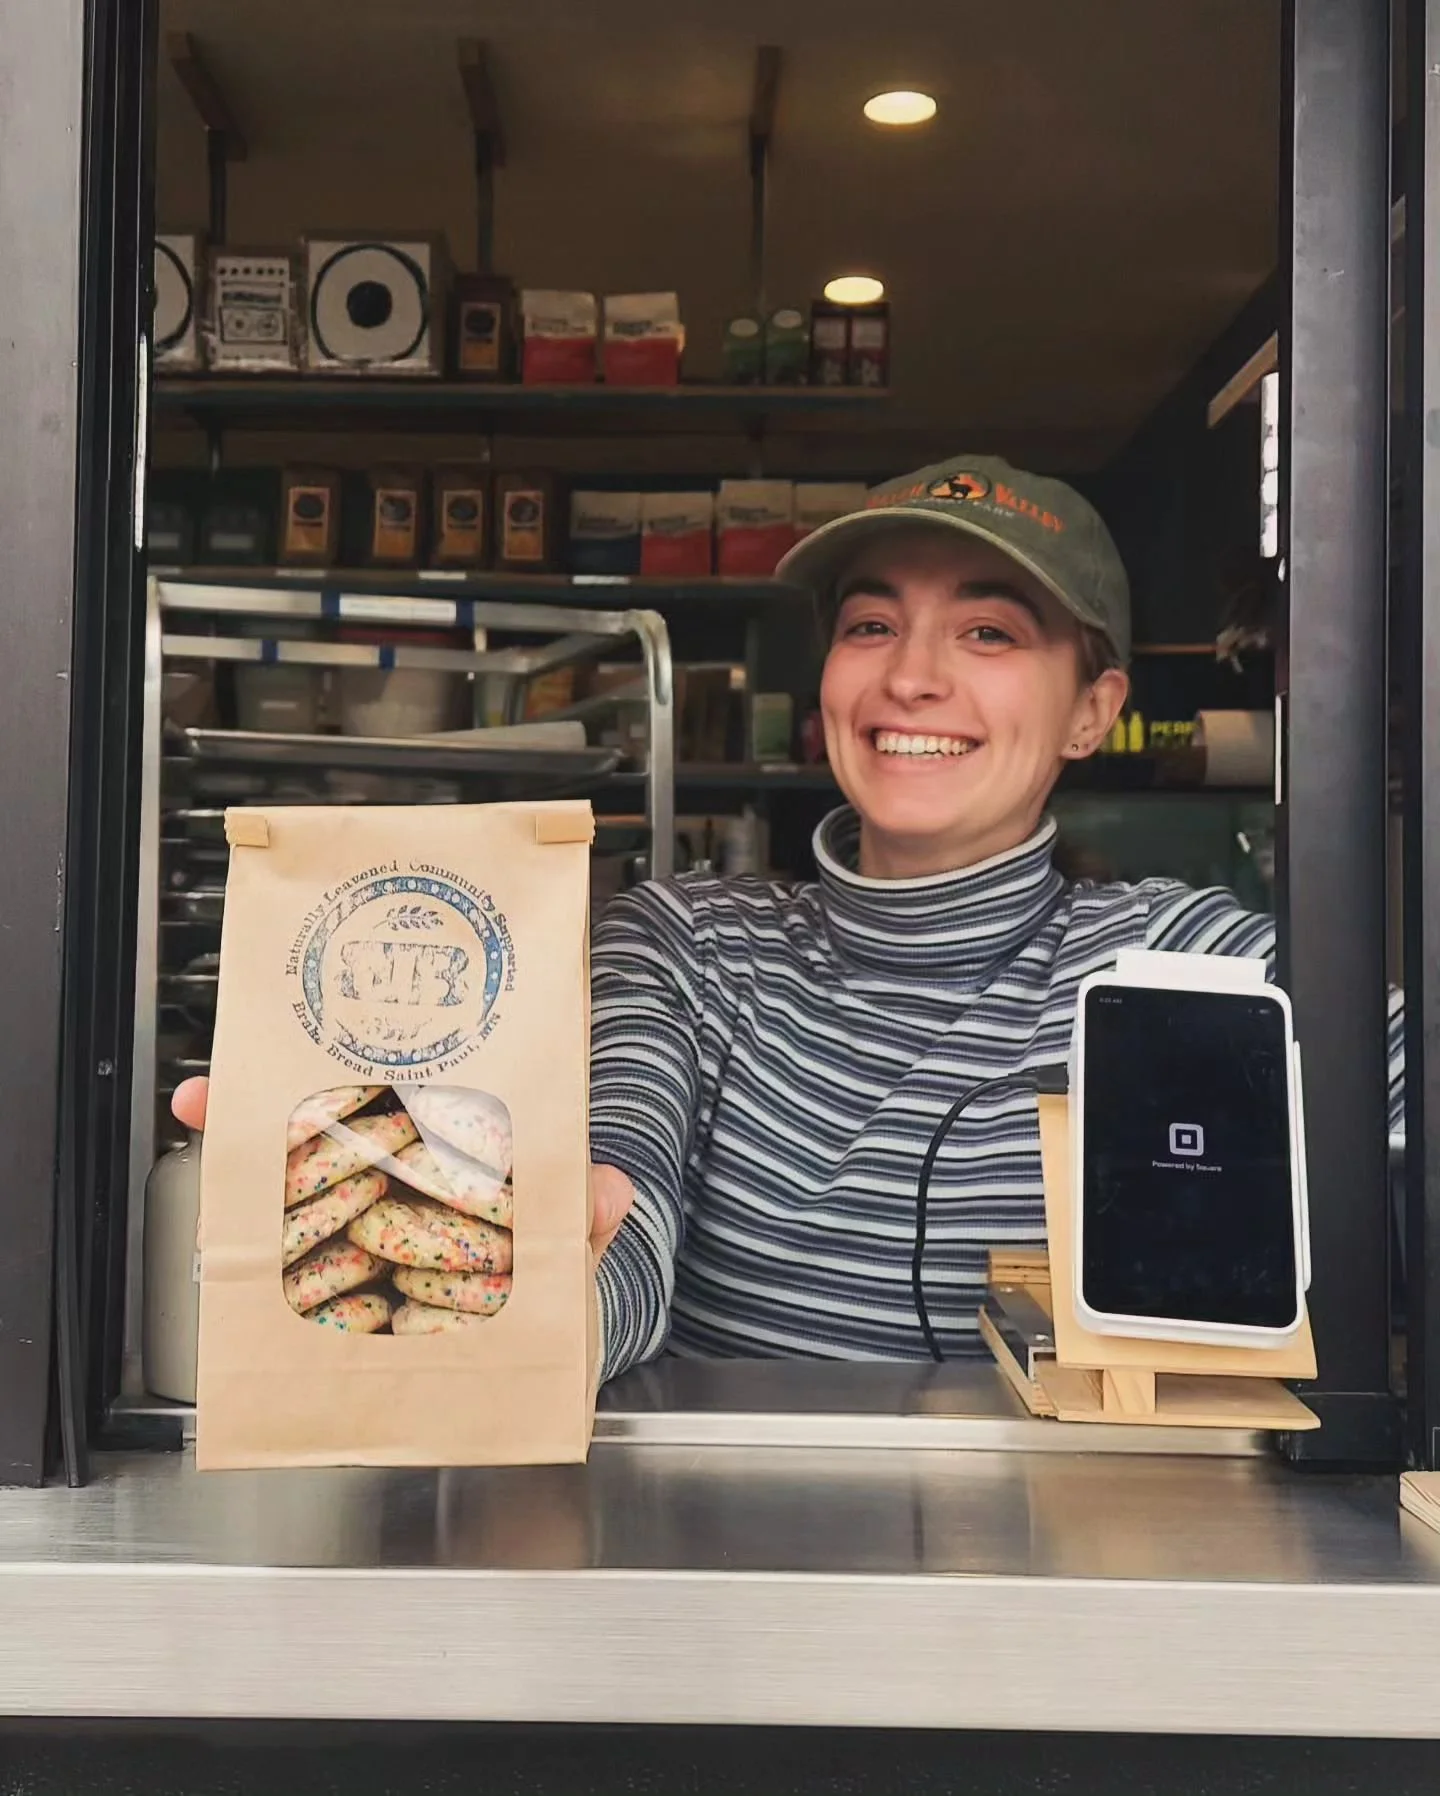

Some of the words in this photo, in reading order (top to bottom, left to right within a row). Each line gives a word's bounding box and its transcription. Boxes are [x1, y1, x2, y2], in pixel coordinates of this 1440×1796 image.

[286, 904, 325, 975] Naturally
[324, 860, 399, 906] Leavened
[292, 1002, 323, 1045] Brake
[326, 1044, 373, 1077] Bread
[384, 1066, 434, 1081] Saint
[1152, 1159, 1185, 1169] Powered
[1185, 1160, 1195, 1172] by
